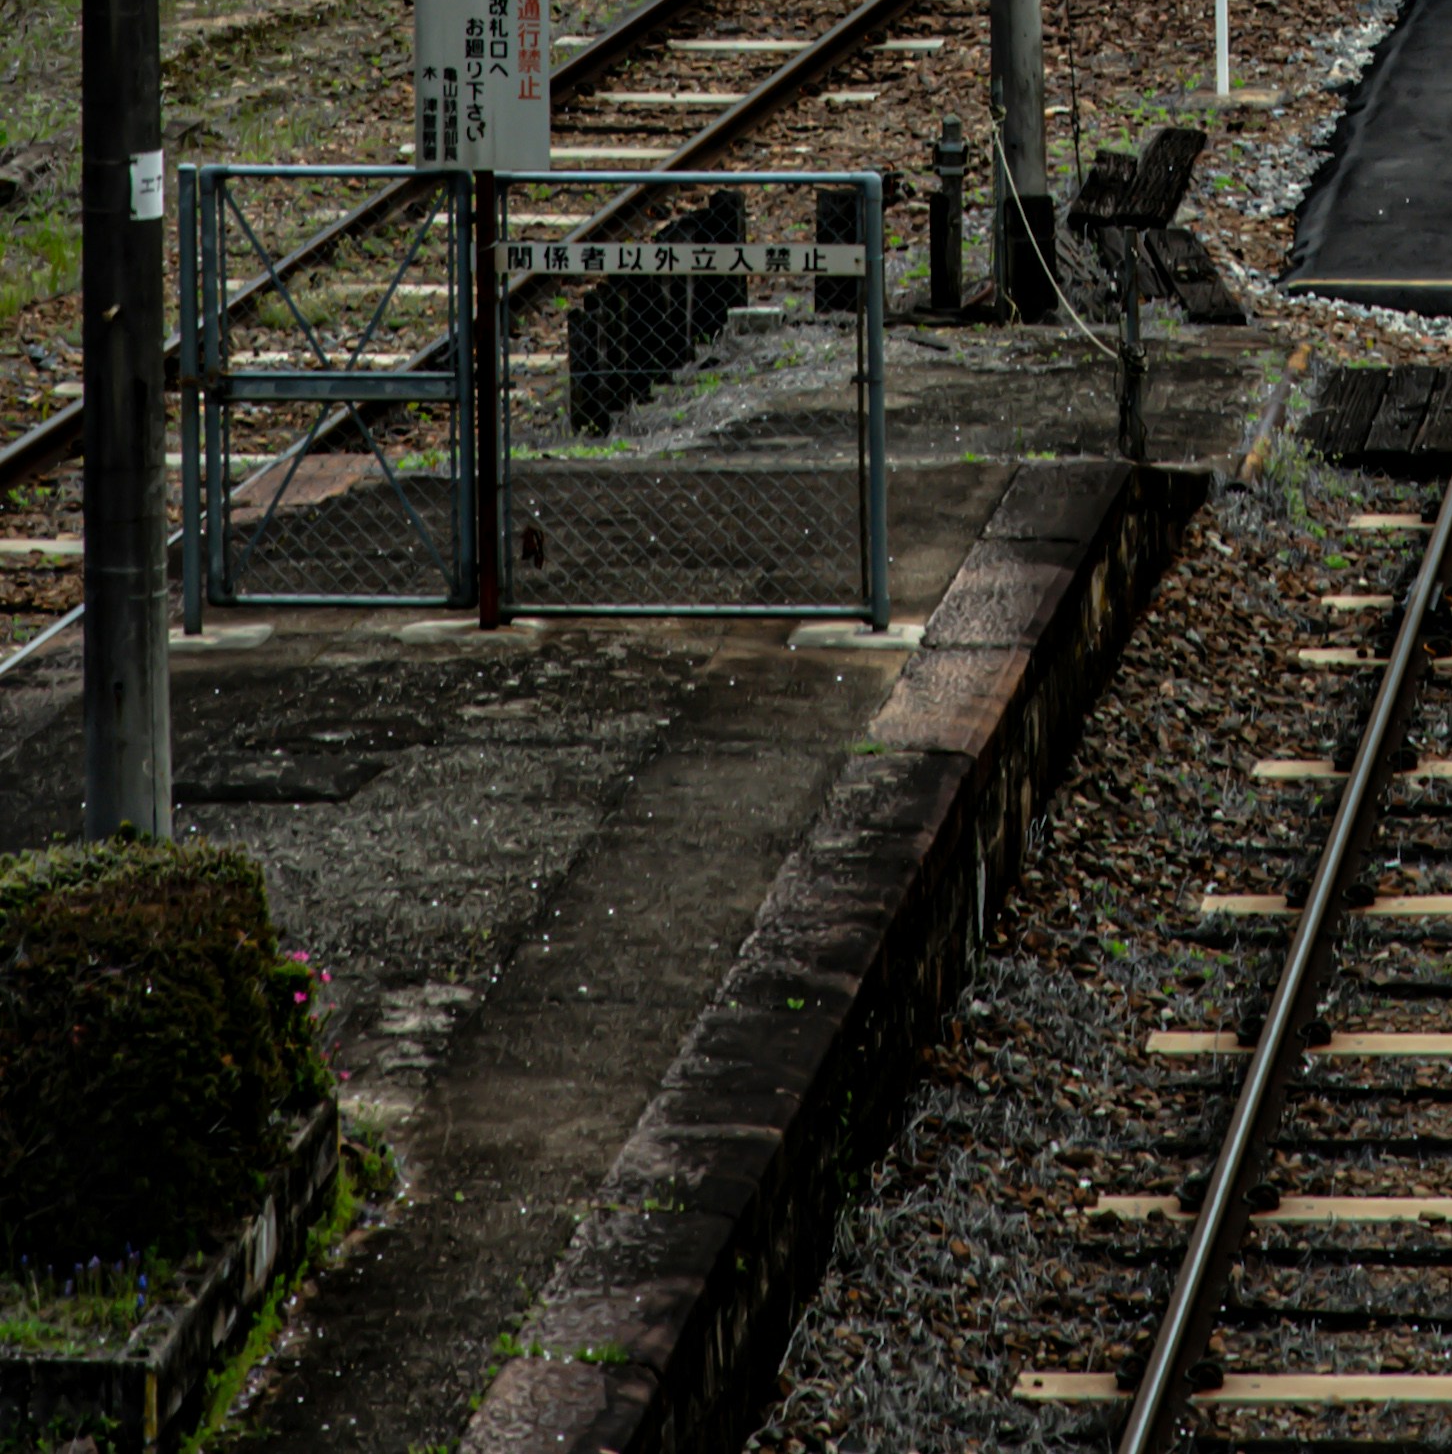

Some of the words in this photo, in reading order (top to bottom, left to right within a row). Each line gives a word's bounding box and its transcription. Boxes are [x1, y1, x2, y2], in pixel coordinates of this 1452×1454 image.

[465, 18, 485, 142] お廻り下さい
[507, 246, 828, 272] 関係者以外立入禁止
